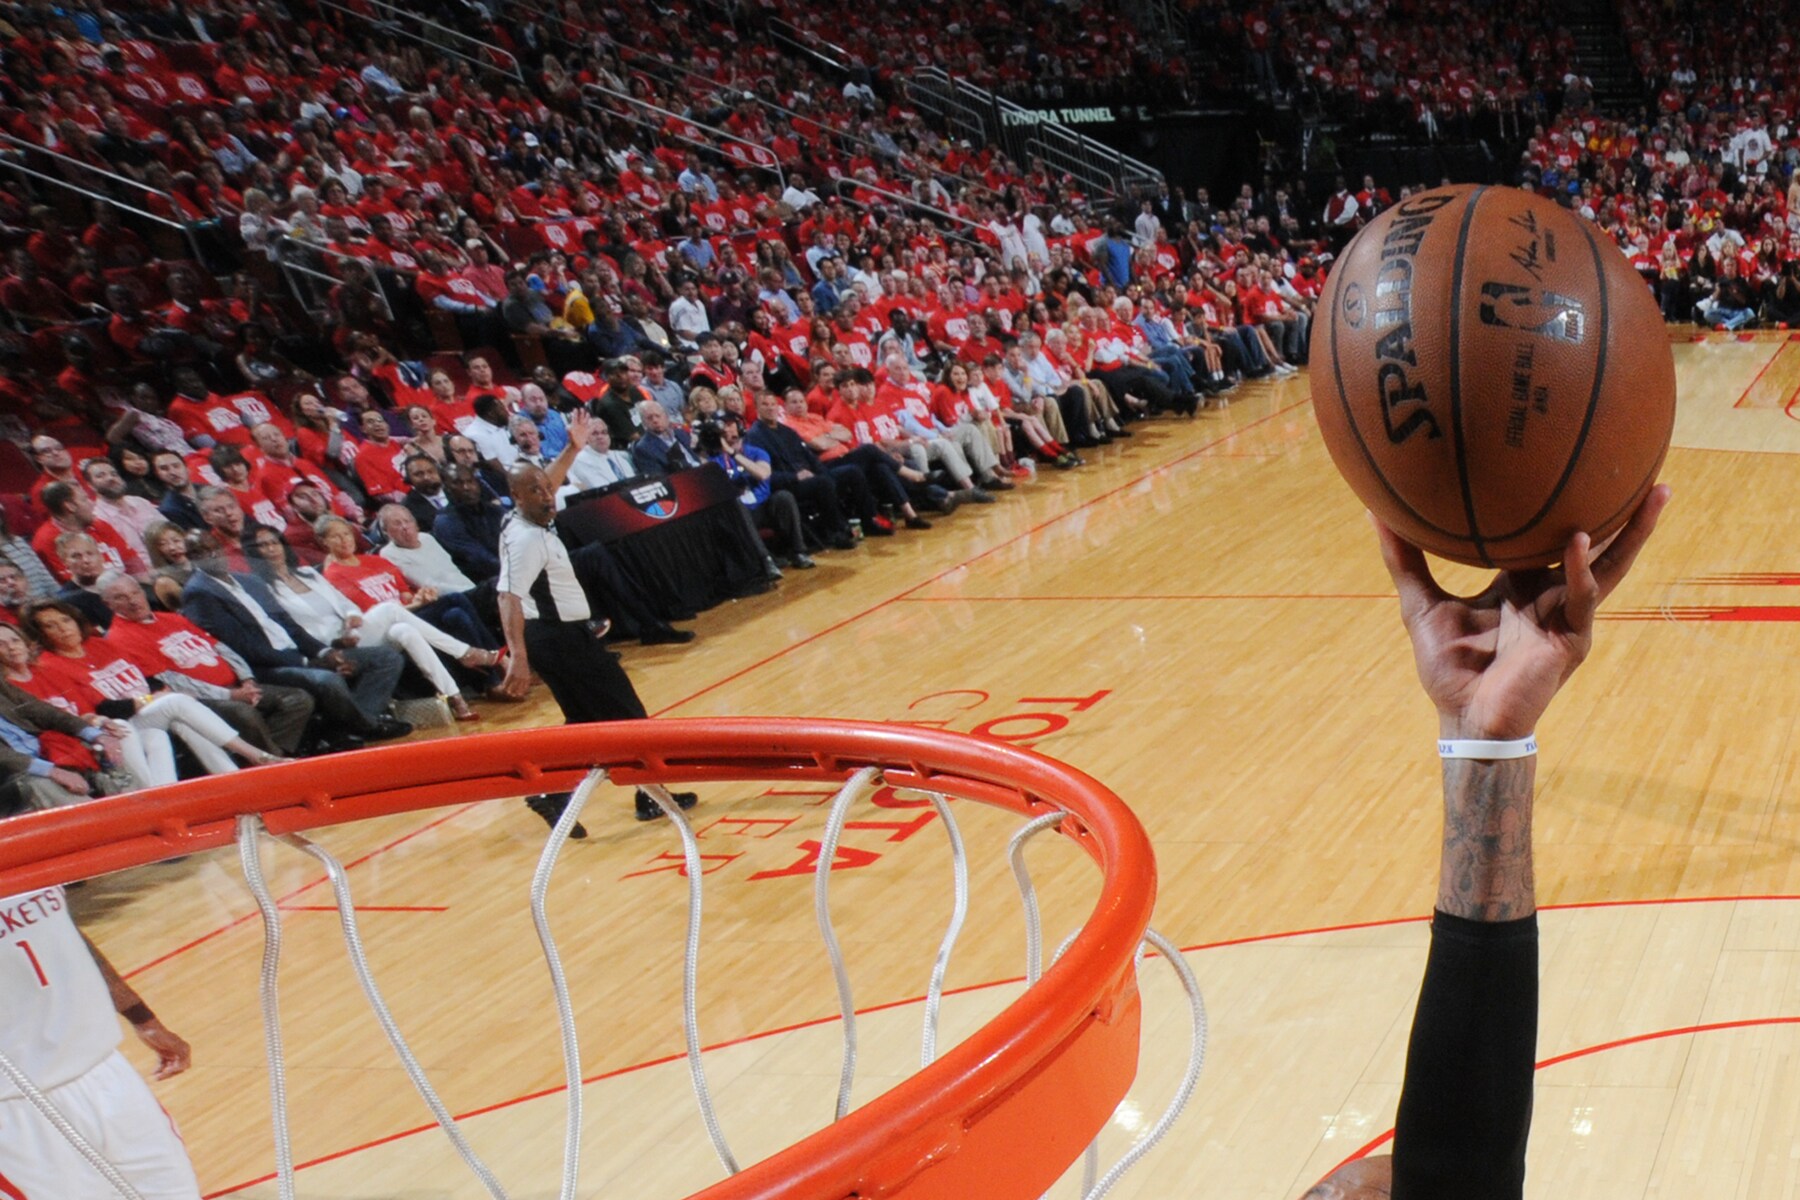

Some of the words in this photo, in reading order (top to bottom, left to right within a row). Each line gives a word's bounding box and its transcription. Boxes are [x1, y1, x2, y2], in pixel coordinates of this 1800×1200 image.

[1060, 107, 1115, 123] TUNNEL
[1373, 192, 1460, 445] SPALDING
[629, 481, 669, 505] ESPN
[0, 889, 61, 939] KETS
[16, 940, 49, 987] 1
